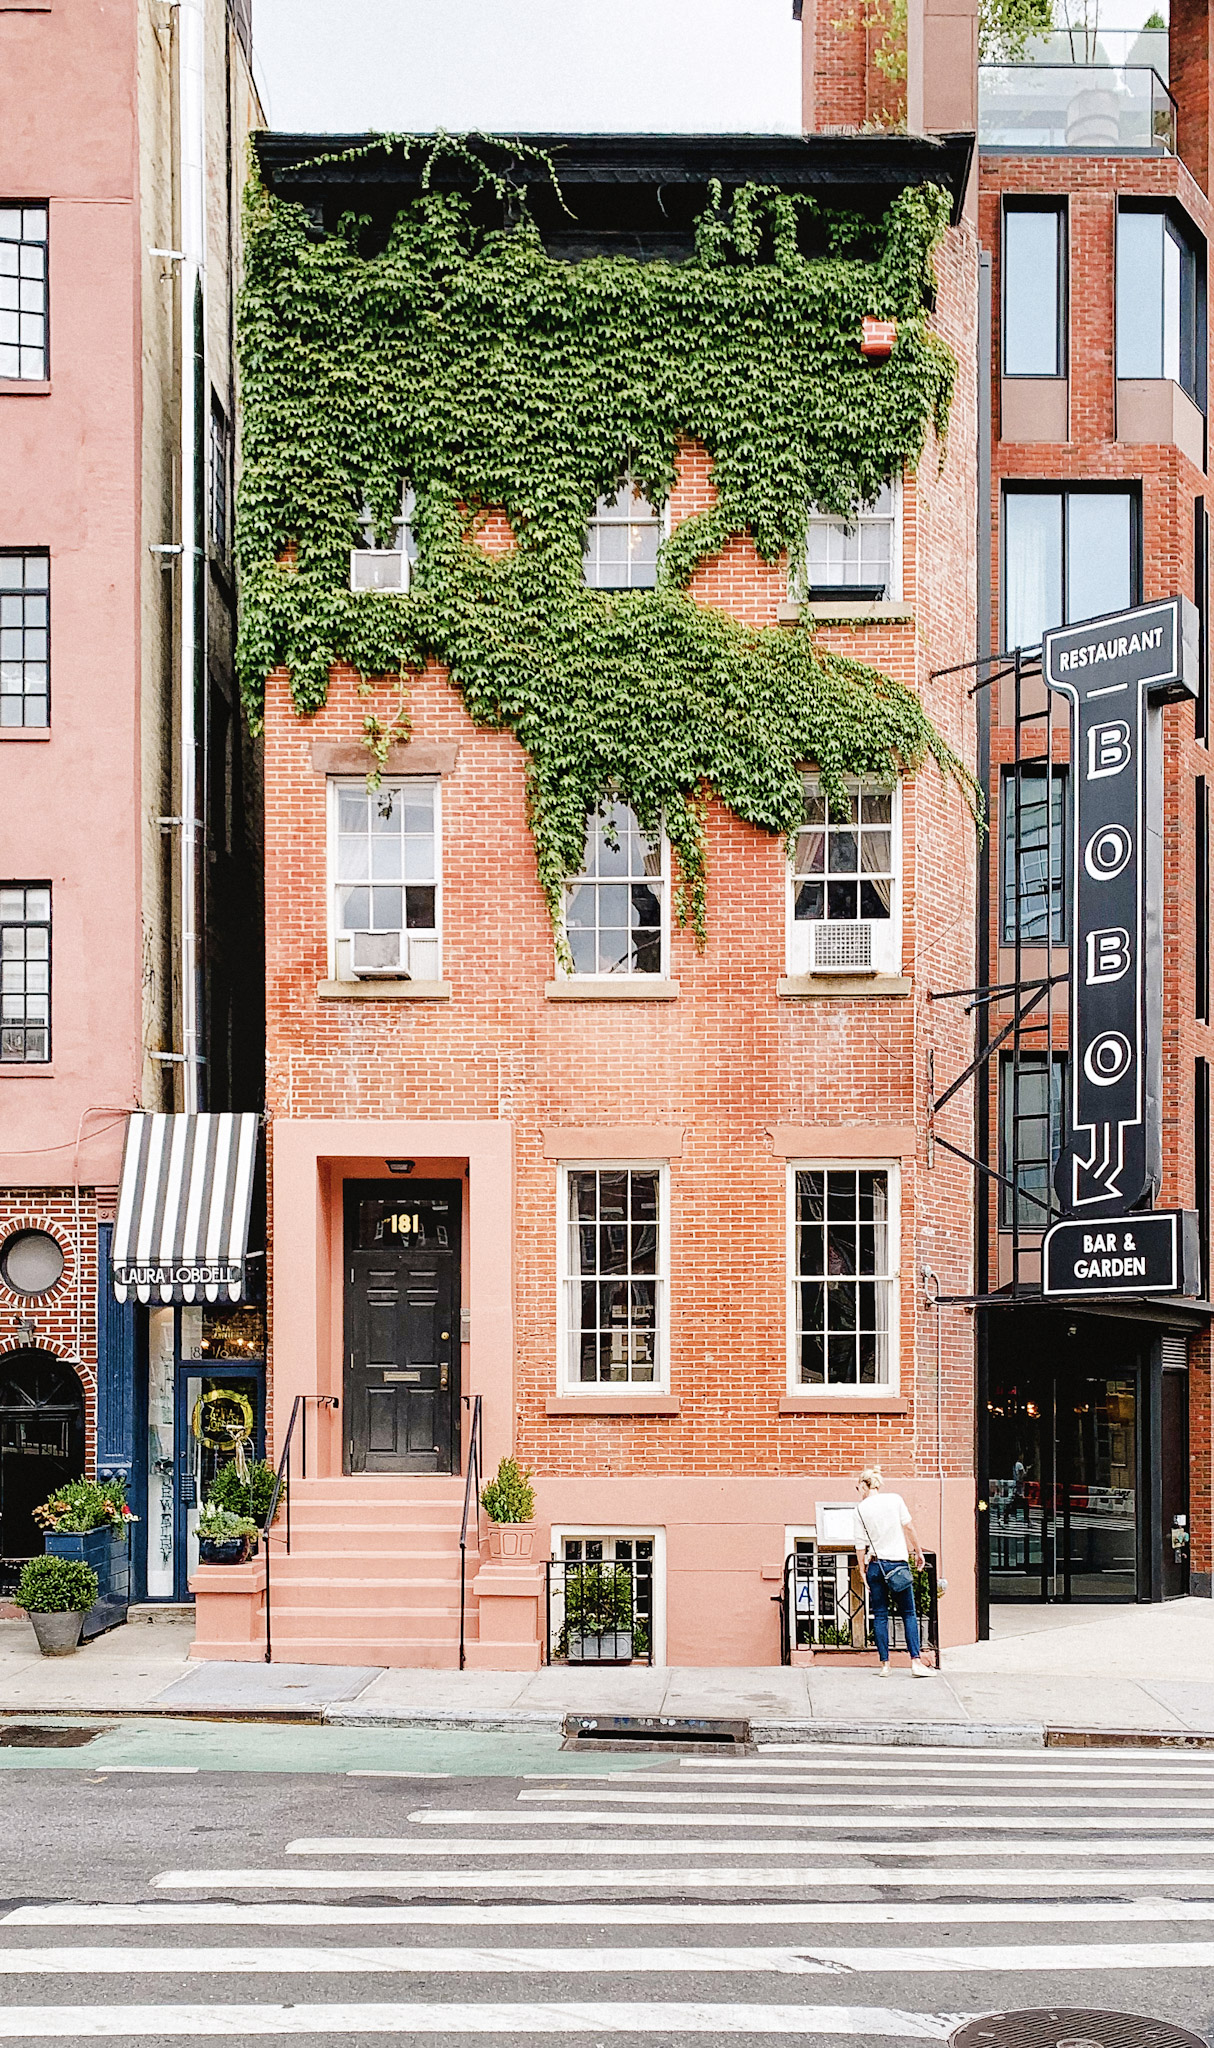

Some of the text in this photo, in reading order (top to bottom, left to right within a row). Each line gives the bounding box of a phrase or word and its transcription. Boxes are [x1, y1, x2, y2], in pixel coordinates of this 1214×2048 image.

[1059, 627, 1163, 672] RESTAURANT
[1083, 719, 1132, 1087] BOBO
[391, 1213, 419, 1233] 181
[1083, 1232, 1136, 1254] BAR &
[121, 1267, 235, 1284] LAURA LOBDELL
[1073, 1256, 1146, 1279] GARDEN
[798, 1585, 813, 1602] A
